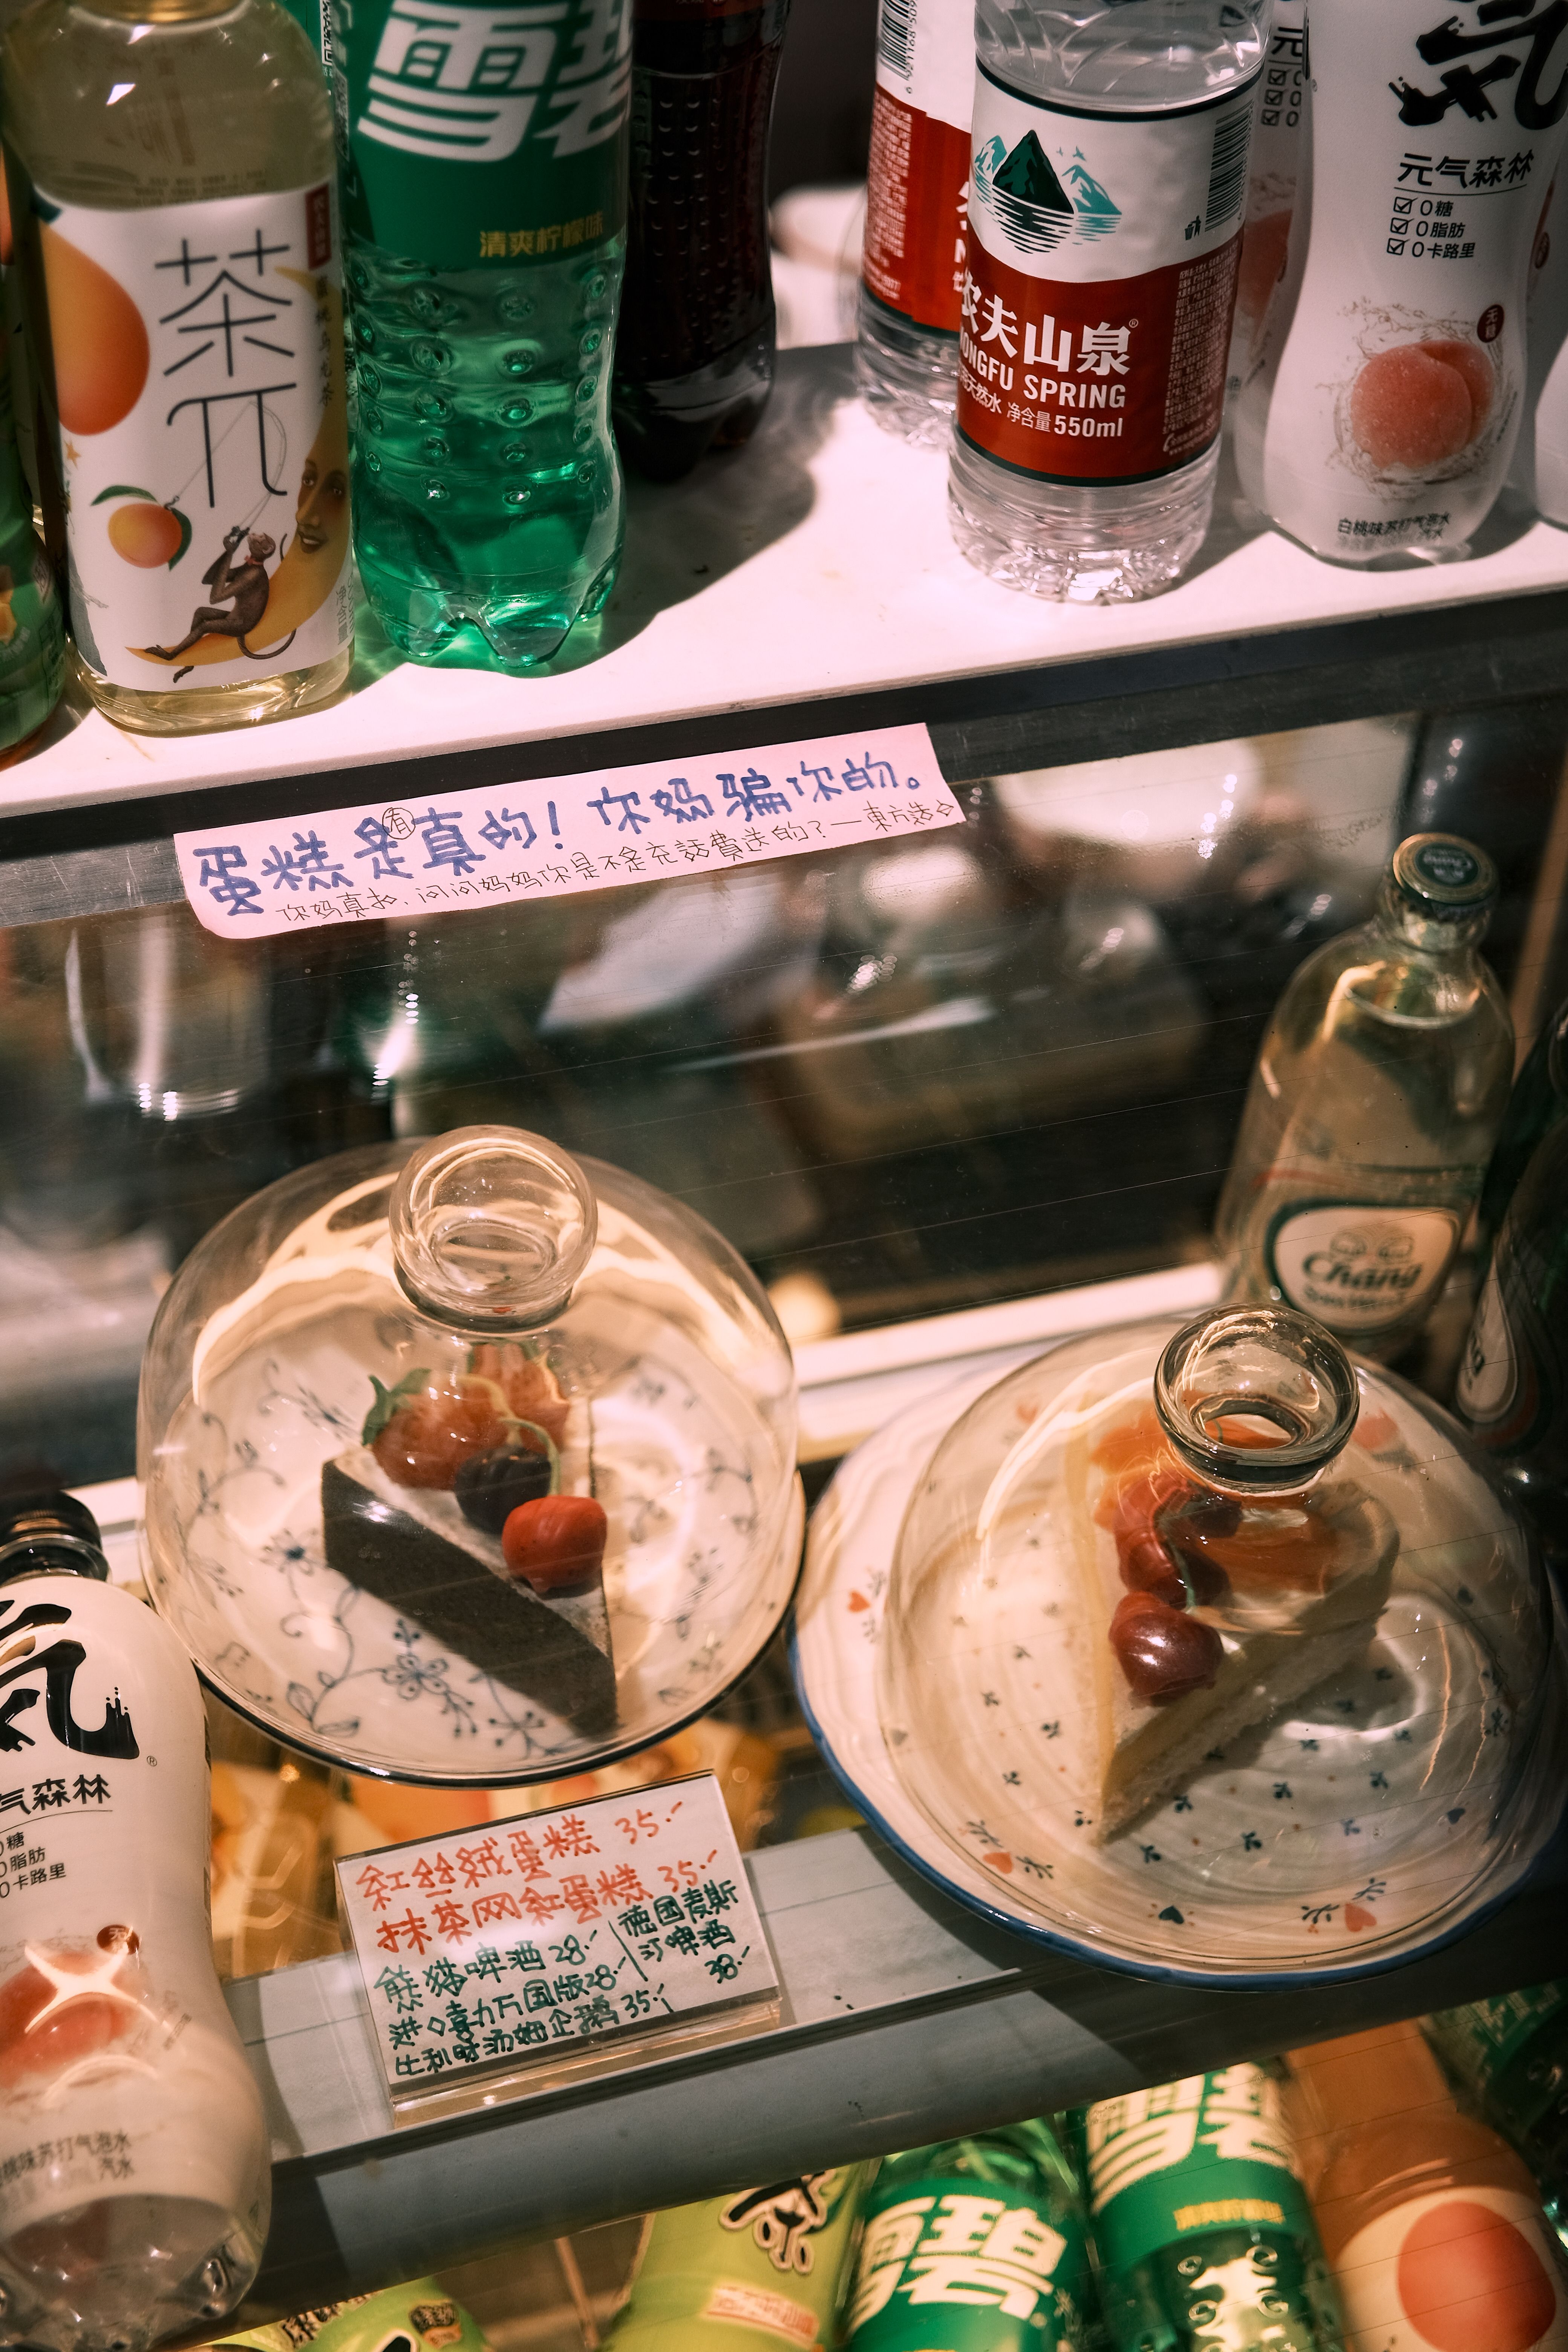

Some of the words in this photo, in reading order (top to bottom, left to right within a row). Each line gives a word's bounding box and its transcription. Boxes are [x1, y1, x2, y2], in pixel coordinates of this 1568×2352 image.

[357, 0, 631, 162] 雪碧
[1397, 149, 1534, 190] 元气森林
[479, 210, 603, 258] 清爽柠檬味
[1411, 242, 1476, 259] 0卡路里
[961, 269, 1131, 376] 农夫山泉
[1023, 374, 1125, 409] SPRING
[1302, 1251, 1423, 1291] Chang
[848, 2194, 1067, 2336] 雪碧
